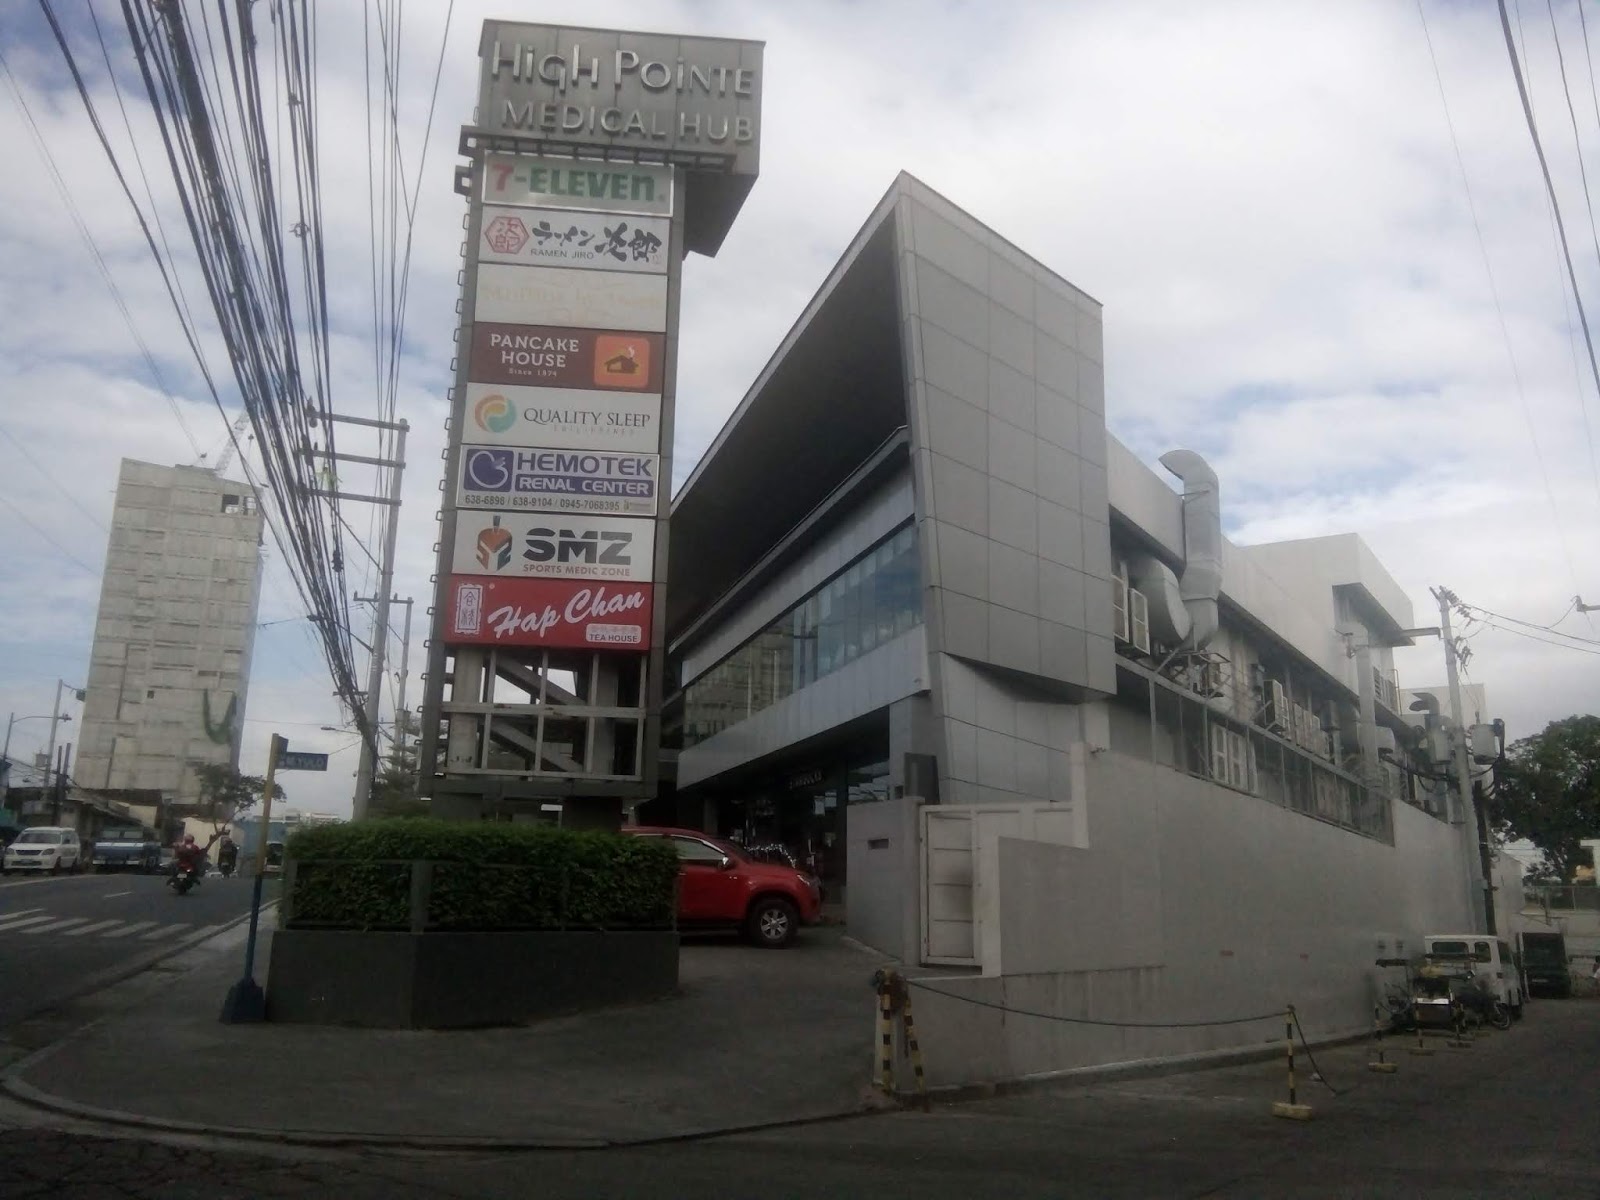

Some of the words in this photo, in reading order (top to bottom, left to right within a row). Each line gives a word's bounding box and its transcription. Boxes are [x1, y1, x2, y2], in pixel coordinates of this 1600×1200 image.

[502, 99, 667, 139] MEDICAL
[680, 112, 754, 142] HUB
[530, 247, 568, 260] RAMEN
[571, 250, 595, 261] JIRO
[491, 333, 580, 353] PANCAKE
[501, 350, 567, 369] HOUSE
[508, 368, 532, 376] Since
[523, 407, 602, 425] QUALITY
[606, 411, 651, 428] SLEEP
[517, 452, 653, 477] HEMOTEK
[519, 476, 576, 492] RENAL
[582, 479, 650, 496] CENTER
[512, 497, 553, 508] 638-9104
[522, 526, 633, 566] SMZ
[522, 563, 562, 575] SPORTS
[565, 565, 599, 576] MEDIC
[601, 566, 631, 577] ZONE
[487, 604, 561, 638] Hap
[564, 586, 646, 624] Chan
[589, 634, 606, 642] TEA
[608, 634, 639, 643] HOUSE
